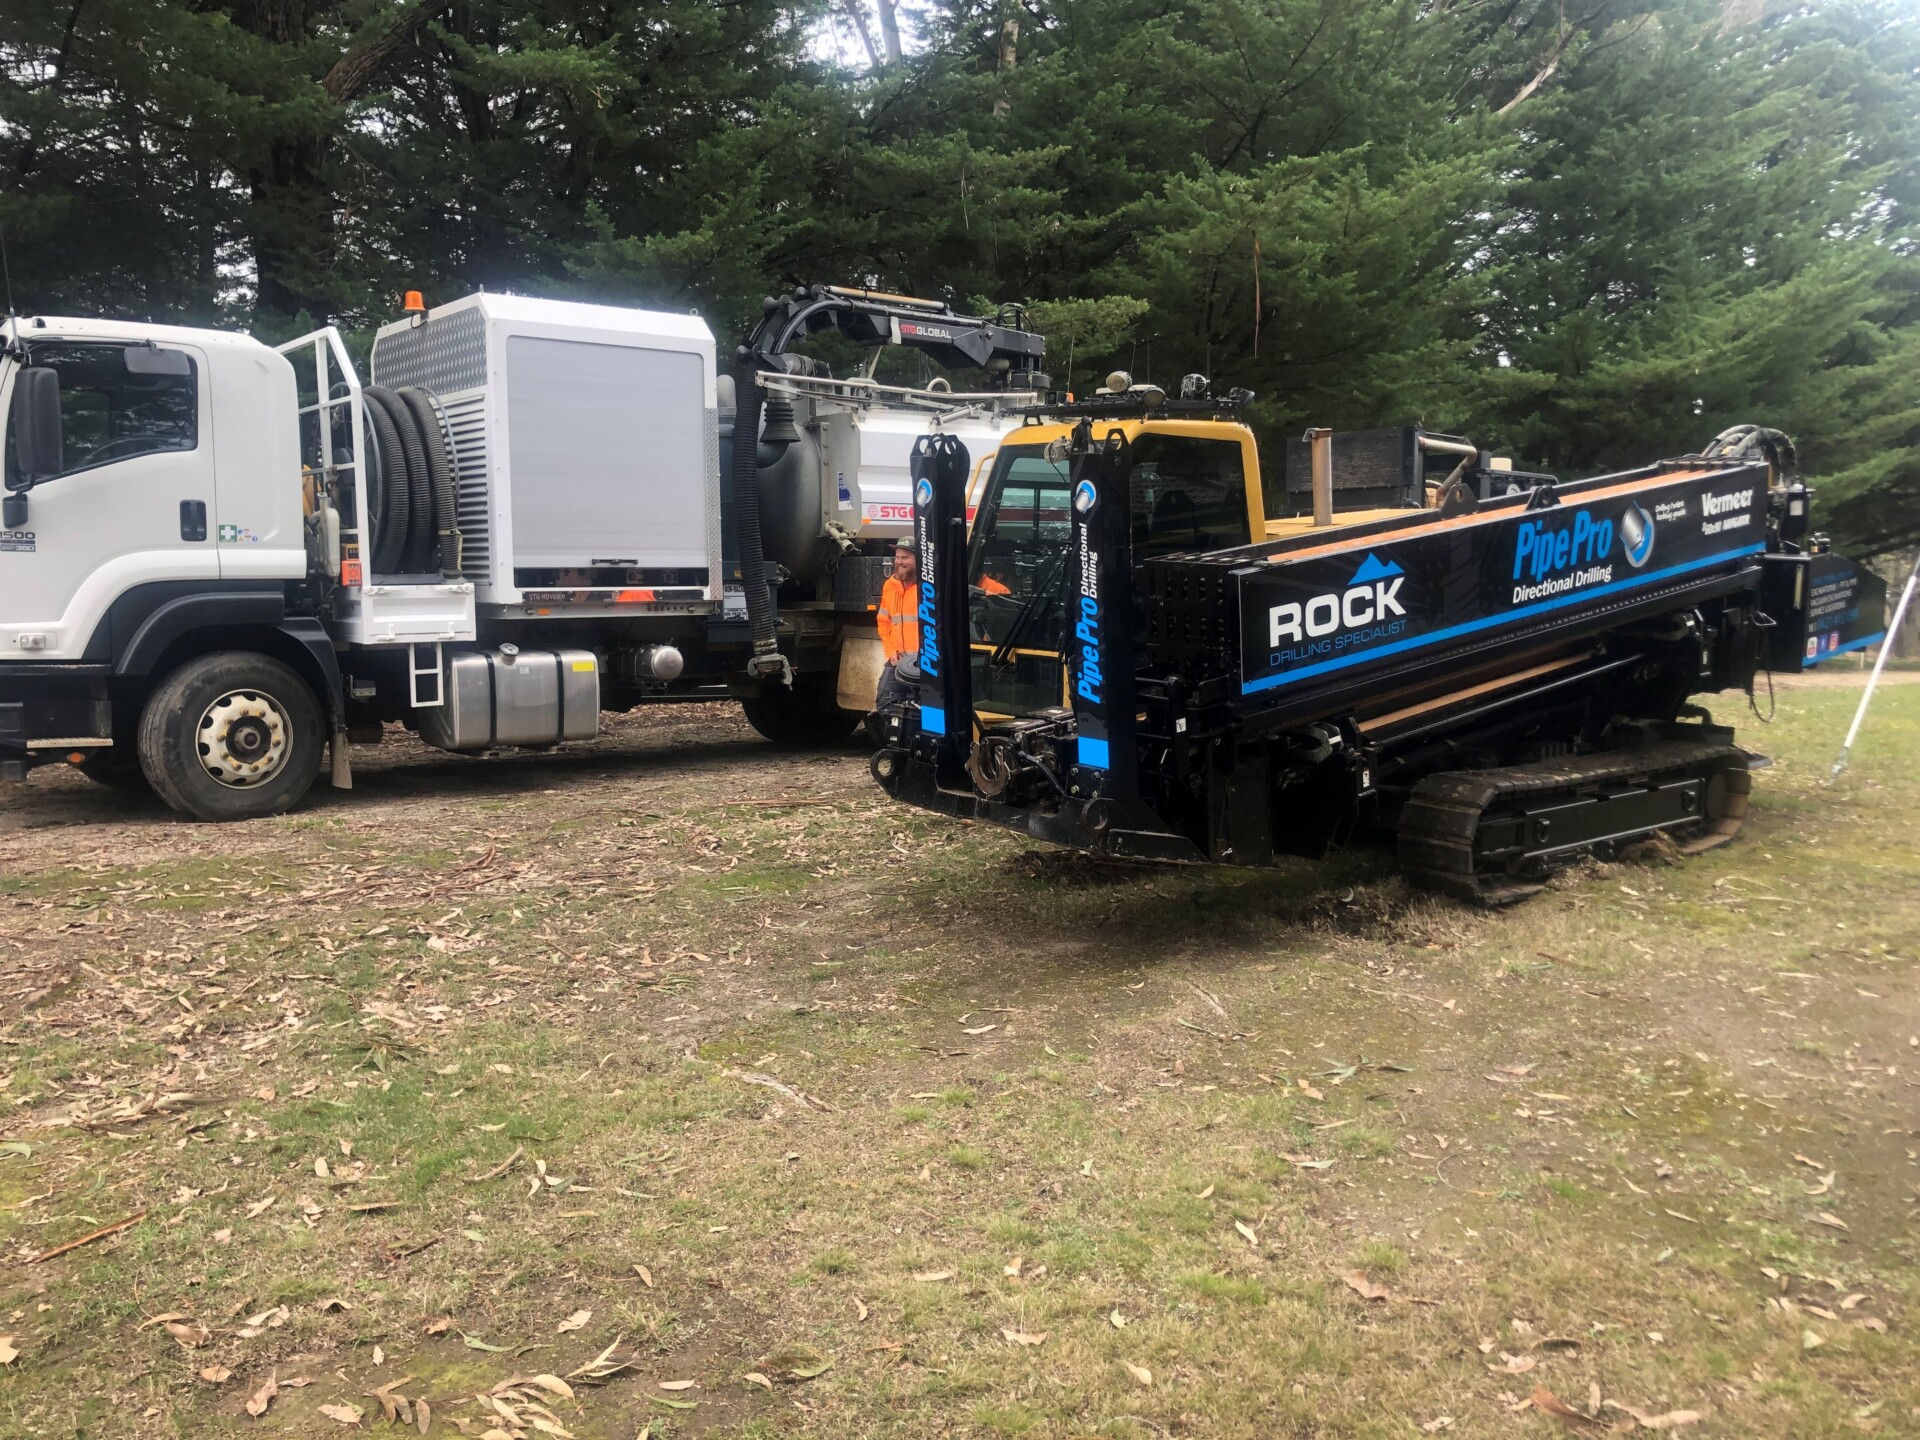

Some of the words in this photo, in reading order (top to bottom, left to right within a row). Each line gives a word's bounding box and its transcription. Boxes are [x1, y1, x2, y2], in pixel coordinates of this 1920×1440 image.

[880, 505, 908, 519] STG
[1701, 489, 1753, 517] Vermeer
[927, 542, 935, 583] Drilling
[1079, 523, 1088, 596] Directional
[1088, 551, 1098, 599] Drilling
[1512, 572, 1574, 604] Directional
[1575, 564, 1613, 587] Drilling
[1269, 576, 1407, 648] ROCK
[1270, 640, 1331, 667] DRILLING
[1335, 620, 1407, 649] SPECIALIST
